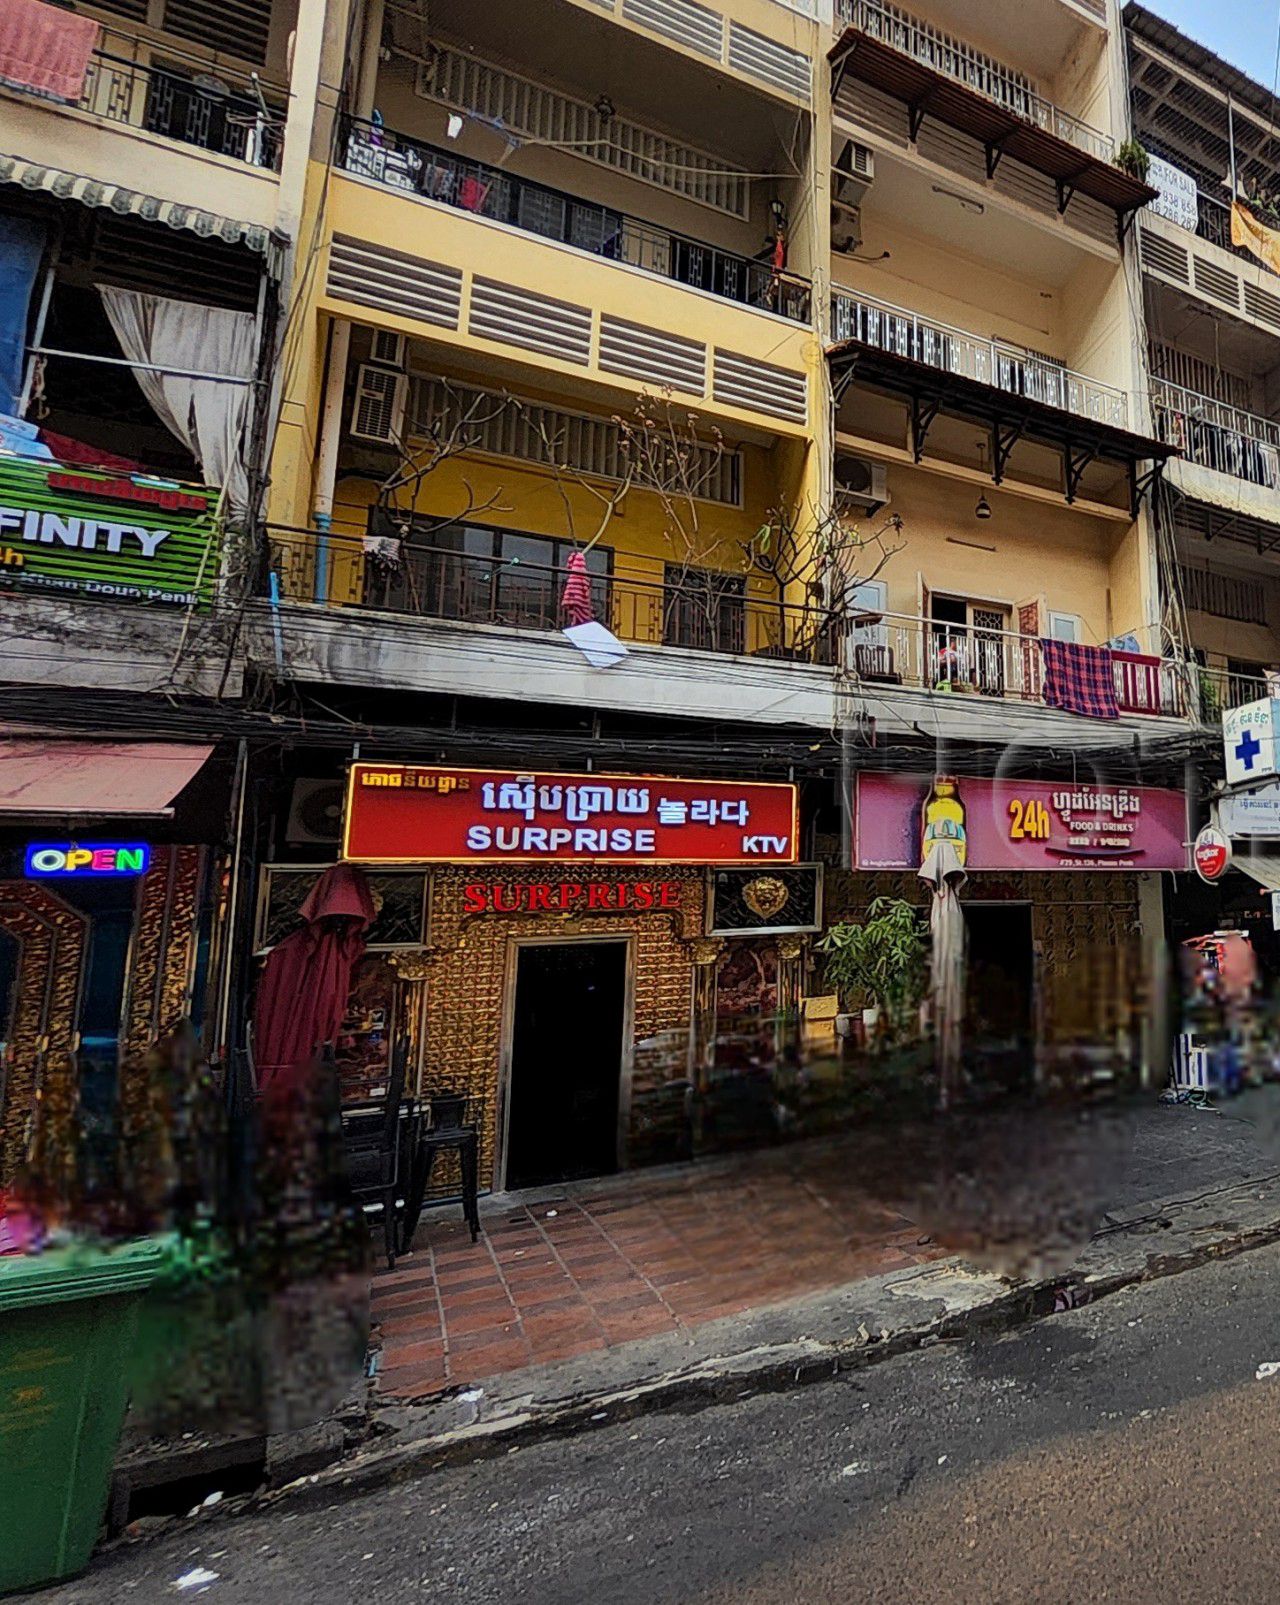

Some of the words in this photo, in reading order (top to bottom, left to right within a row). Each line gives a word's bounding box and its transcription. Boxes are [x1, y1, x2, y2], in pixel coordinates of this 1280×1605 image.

[657, 797, 749, 826] 놀라다
[1010, 799, 1050, 838] 24h
[467, 825, 655, 852] SURPRISE
[1069, 821, 1094, 831] FOOD
[1102, 822, 1134, 832] DRINKS
[742, 835, 788, 853] KTV
[31, 848, 144, 871] OPEN
[465, 883, 682, 912] SURPRISE
